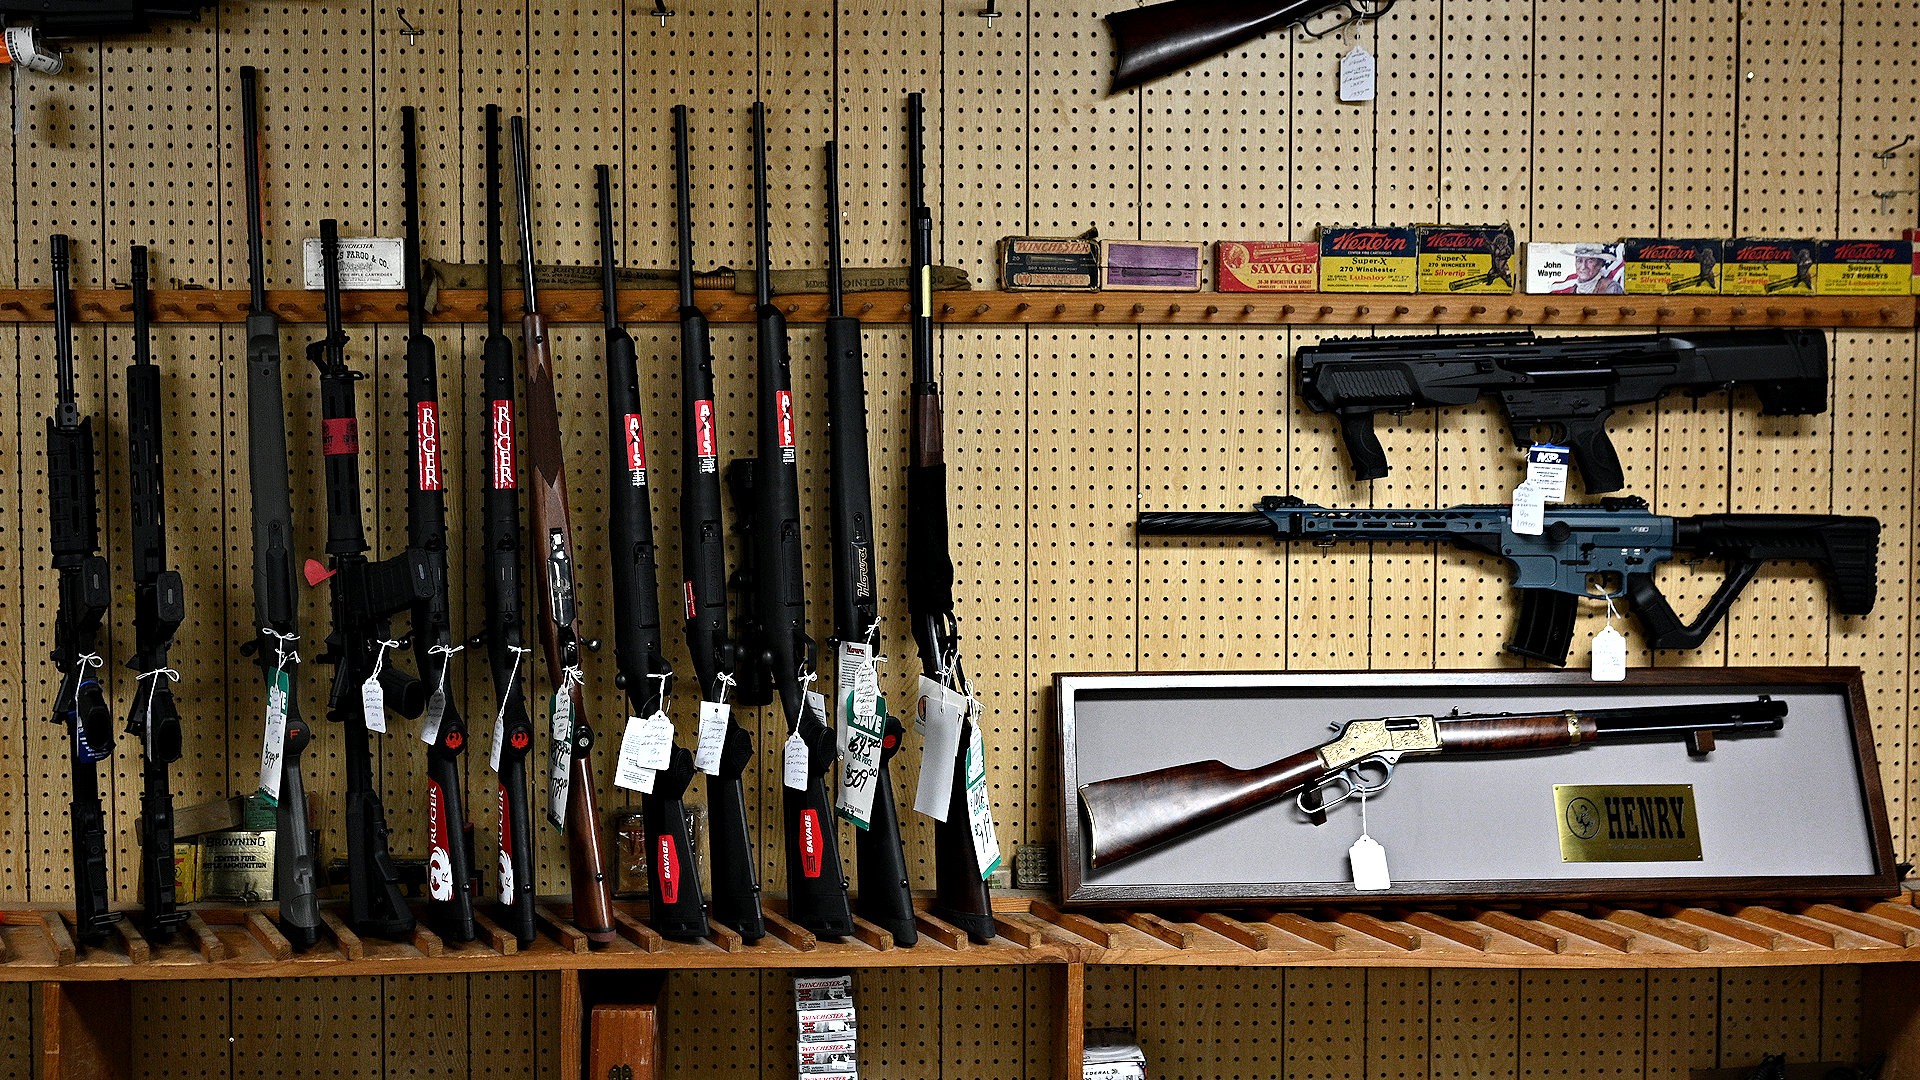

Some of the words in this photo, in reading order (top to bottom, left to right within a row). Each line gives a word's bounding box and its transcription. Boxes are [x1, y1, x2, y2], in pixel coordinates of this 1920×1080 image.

[1016, 242, 1090, 252] WINCHESTER
[1332, 231, 1408, 250] Western
[1426, 232, 1484, 248] Western
[346, 250, 369, 260] FARGO
[1639, 244, 1696, 259] Western
[1737, 245, 1792, 260] Western
[1834, 243, 1897, 259] Western
[1250, 263, 1313, 274] SAVAGE
[1352, 257, 1388, 265] Super-X
[1543, 261, 1562, 269] John
[1434, 269, 1466, 278] Silvertip
[1537, 270, 1562, 278] Wayne
[842, 277, 885, 288] OINTED
[781, 395, 792, 447] AXIS
[699, 404, 712, 454] AXIS
[422, 407, 439, 486] RUGER
[497, 406, 514, 483] RUGER
[629, 417, 642, 467] AXIS
[853, 715, 883, 734] SAVE
[430, 785, 438, 844] RUGER
[1604, 796, 1686, 840] HENRY
[804, 814, 814, 854] SAVAGE
[206, 837, 266, 848] BROWNING
[662, 840, 671, 879] SAVAGE
[801, 1013, 844, 1021] WINCHESTER
[801, 1044, 844, 1052] WINCHESTER
